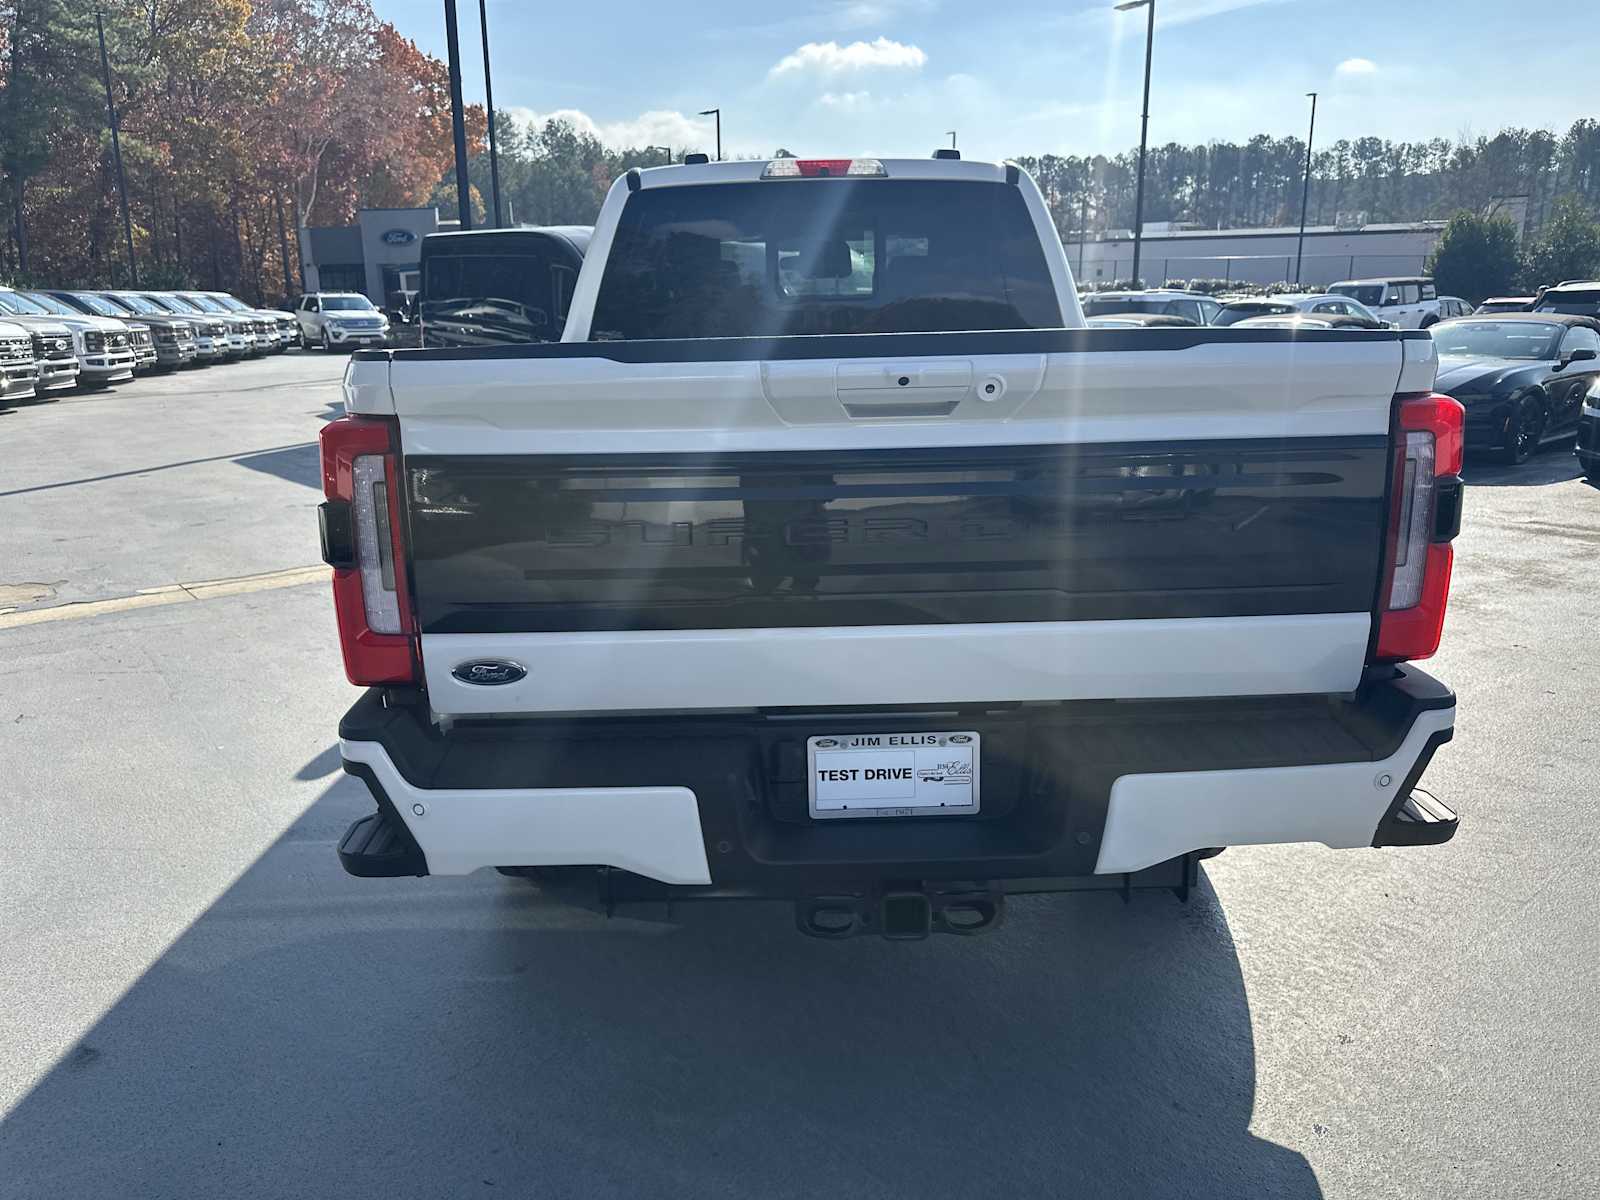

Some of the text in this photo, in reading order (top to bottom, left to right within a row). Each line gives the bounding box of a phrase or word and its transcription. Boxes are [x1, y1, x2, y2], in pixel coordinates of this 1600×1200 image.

[469, 665, 510, 681] Ford
[850, 735, 937, 747] JIM ELLIS
[818, 768, 859, 782] TEST
[864, 767, 913, 781] DRIVE
